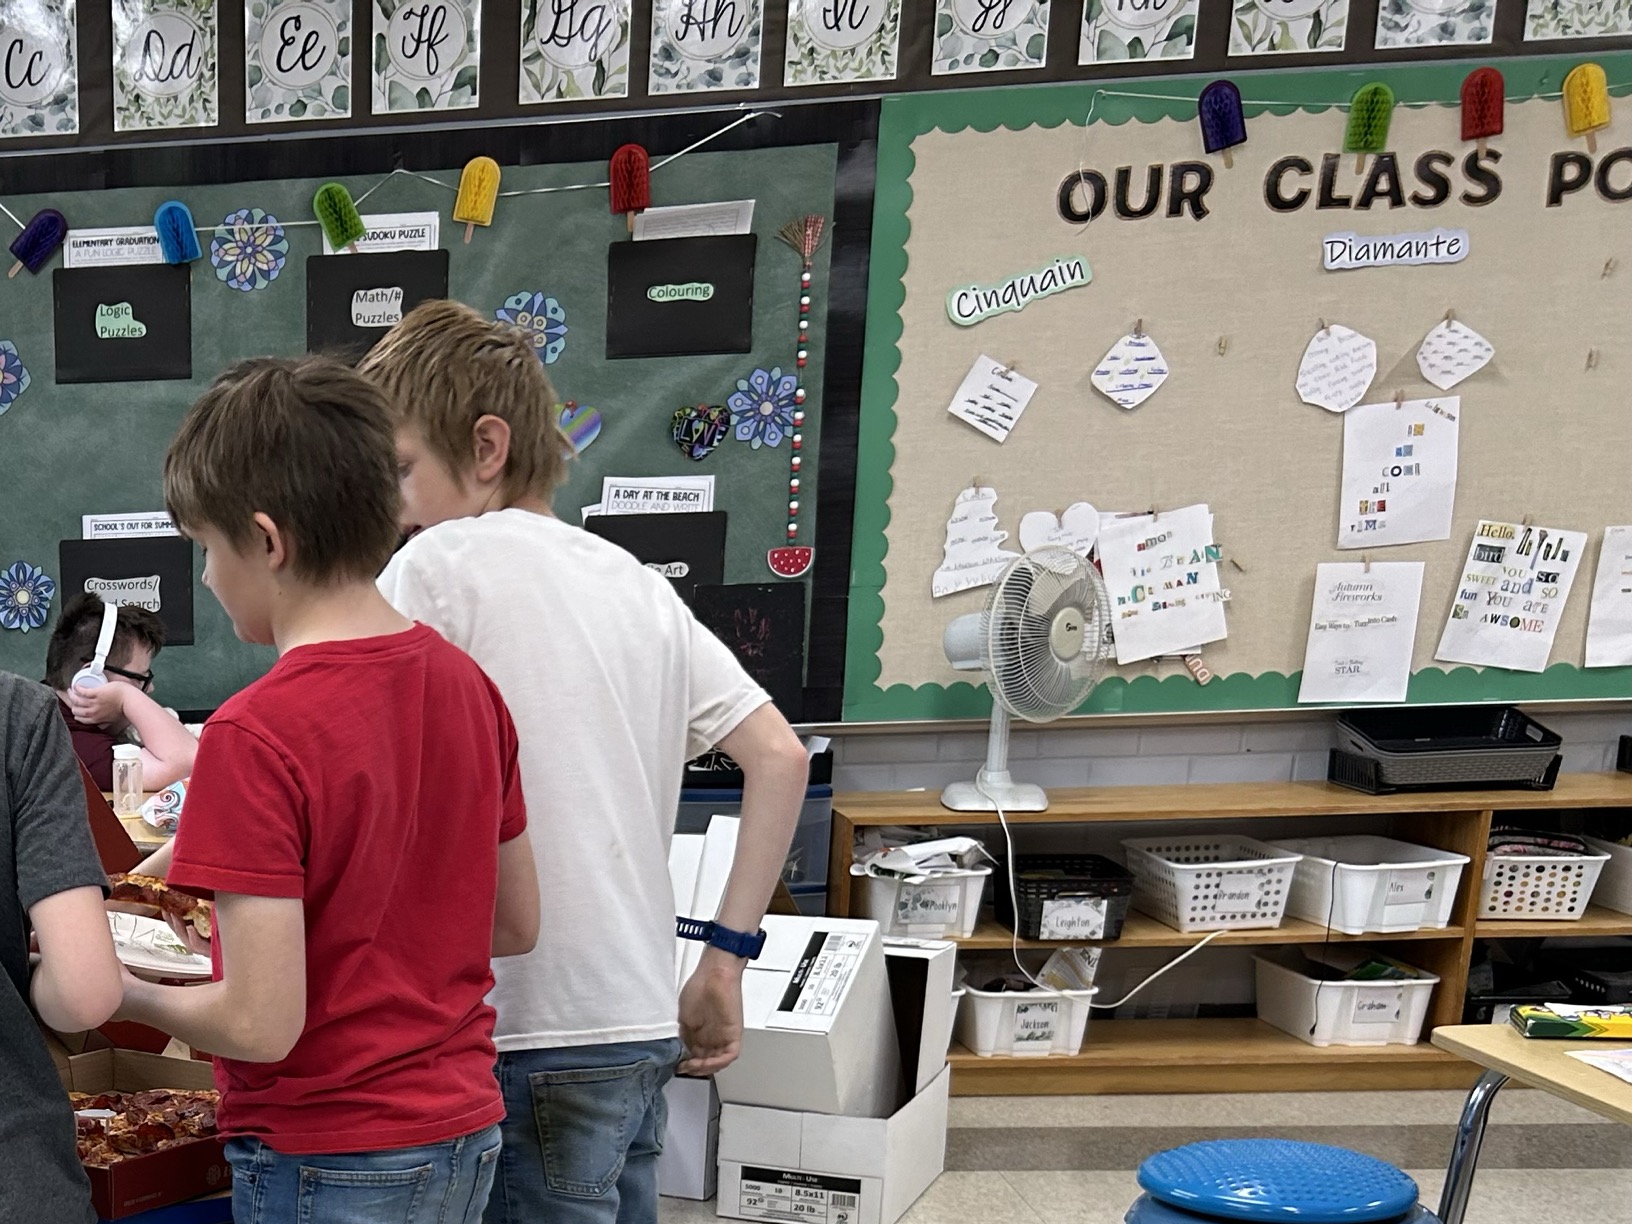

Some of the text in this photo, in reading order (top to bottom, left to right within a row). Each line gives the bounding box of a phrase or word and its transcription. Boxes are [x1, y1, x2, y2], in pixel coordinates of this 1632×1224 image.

[276, 14, 326, 73] Ee
[401, 3, 449, 76] Ff
[133, 29, 202, 83] Dd
[4, 39, 52, 89] Cc
[1058, 160, 1214, 225] OUR
[1265, 149, 1502, 214] CLASS
[398, 228, 426, 239] PUZZLE
[72, 236, 160, 248] ELEMENTARY GRADUATION
[1325, 234, 1462, 266] Diamante
[648, 283, 711, 300] Colouring
[955, 258, 1085, 321] Cinquain
[355, 289, 402, 304] Math/#
[100, 305, 131, 319] Logic
[355, 311, 399, 324] Puzzles
[100, 325, 143, 338] Puzzles
[614, 490, 700, 502] A DAY AT THE BEACH
[128, 522, 139, 530] OUT
[141, 521, 153, 530] FOR
[665, 565, 684, 576] Art
[86, 577, 159, 591] Crosswords/
[1460, 589, 1478, 601] fun
[1335, 665, 1361, 675] STAR
[1020, 1018, 1049, 1030] Jackson
[794, 1204, 805, 1212] 20
